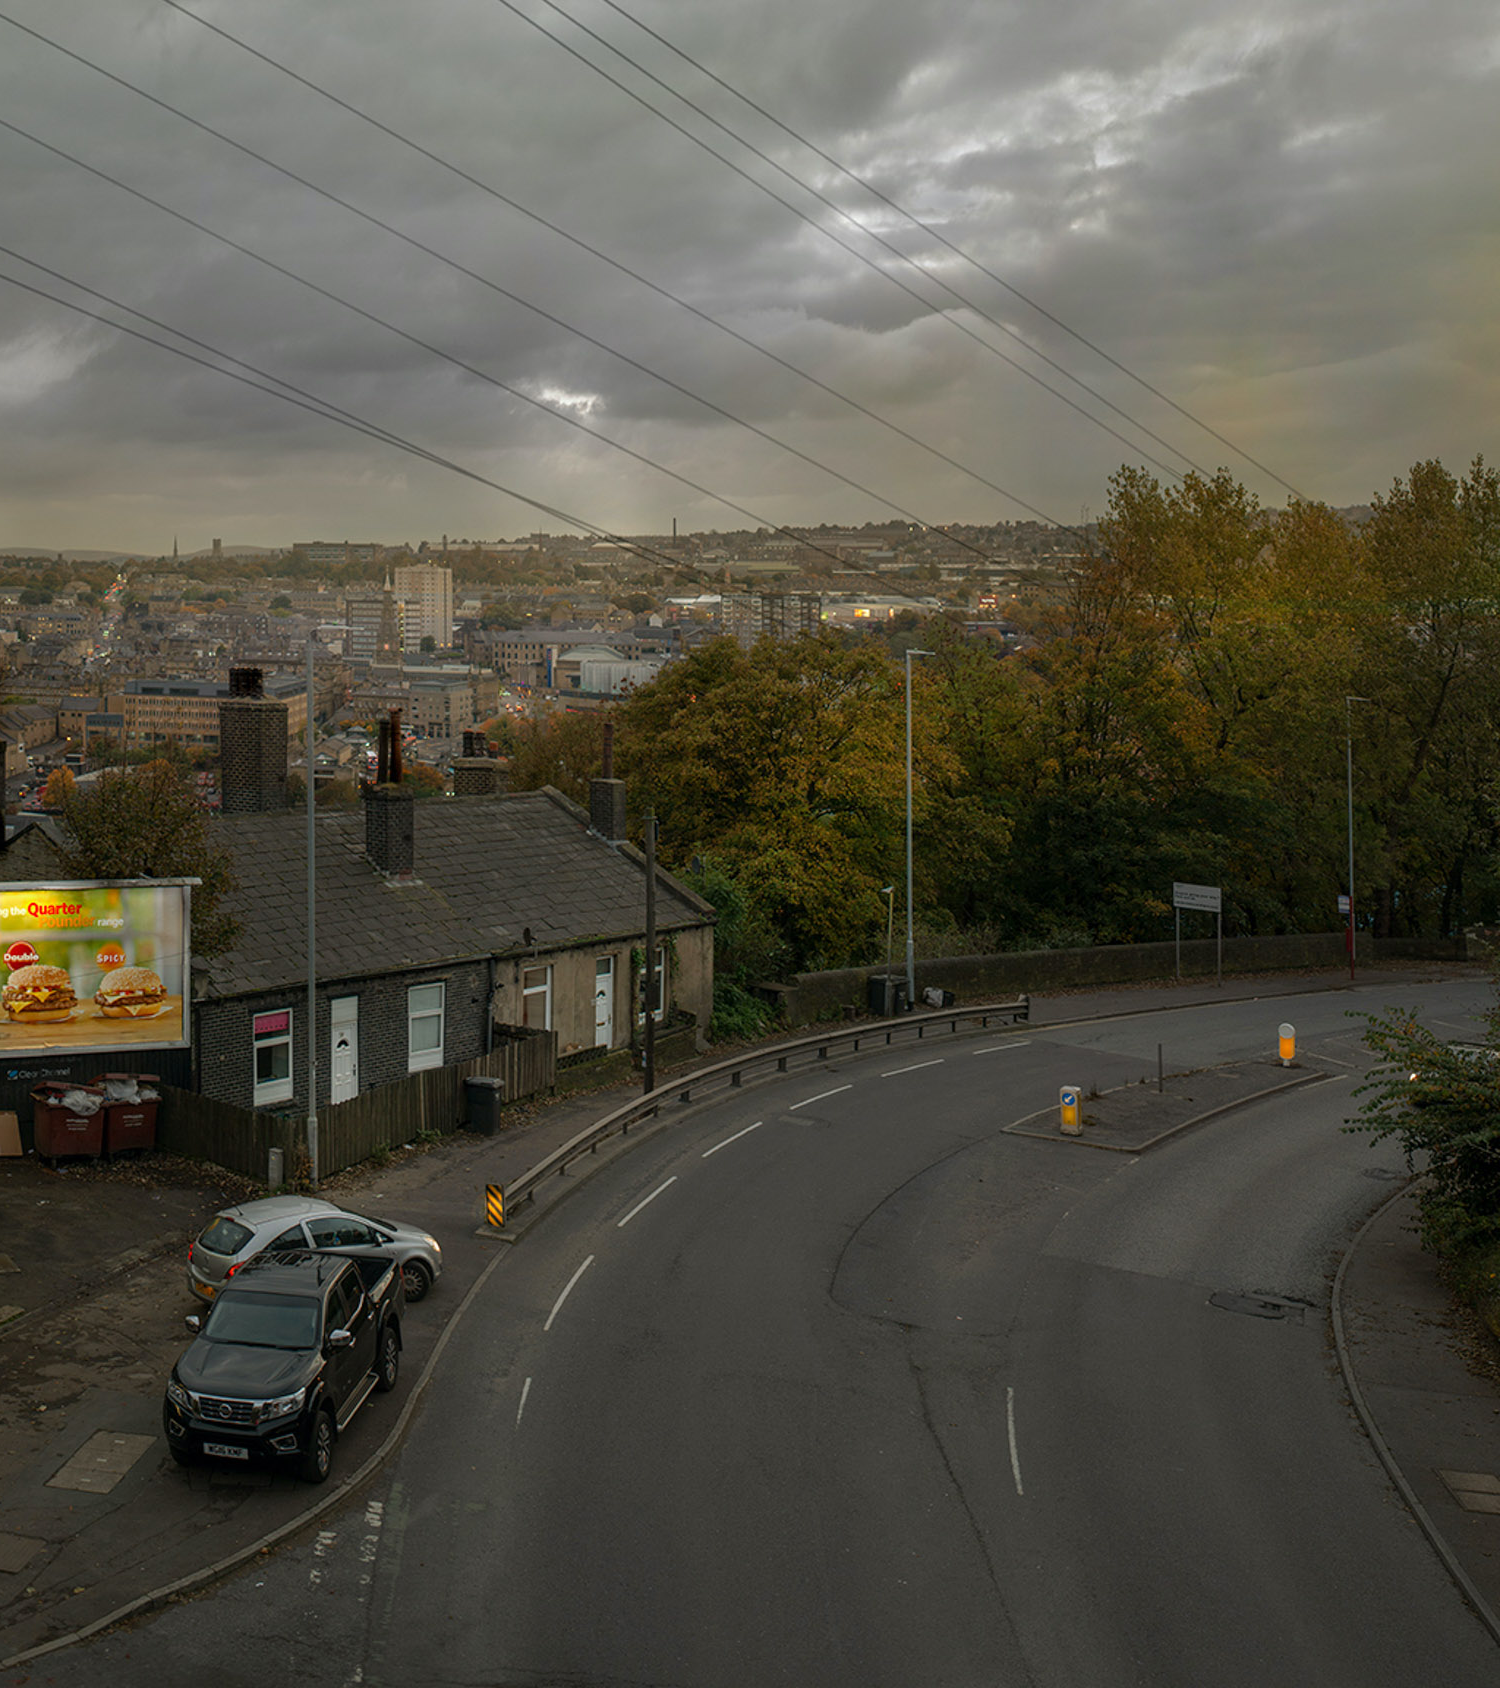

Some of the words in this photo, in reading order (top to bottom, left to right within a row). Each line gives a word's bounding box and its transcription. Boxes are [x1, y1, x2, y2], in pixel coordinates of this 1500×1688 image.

[10, 906, 26, 916] the
[27, 902, 82, 917] Quarter
[39, 914, 95, 928] Pounder
[97, 918, 124, 928] range
[4, 953, 39, 961] Double
[97, 953, 126, 963] SPICY
